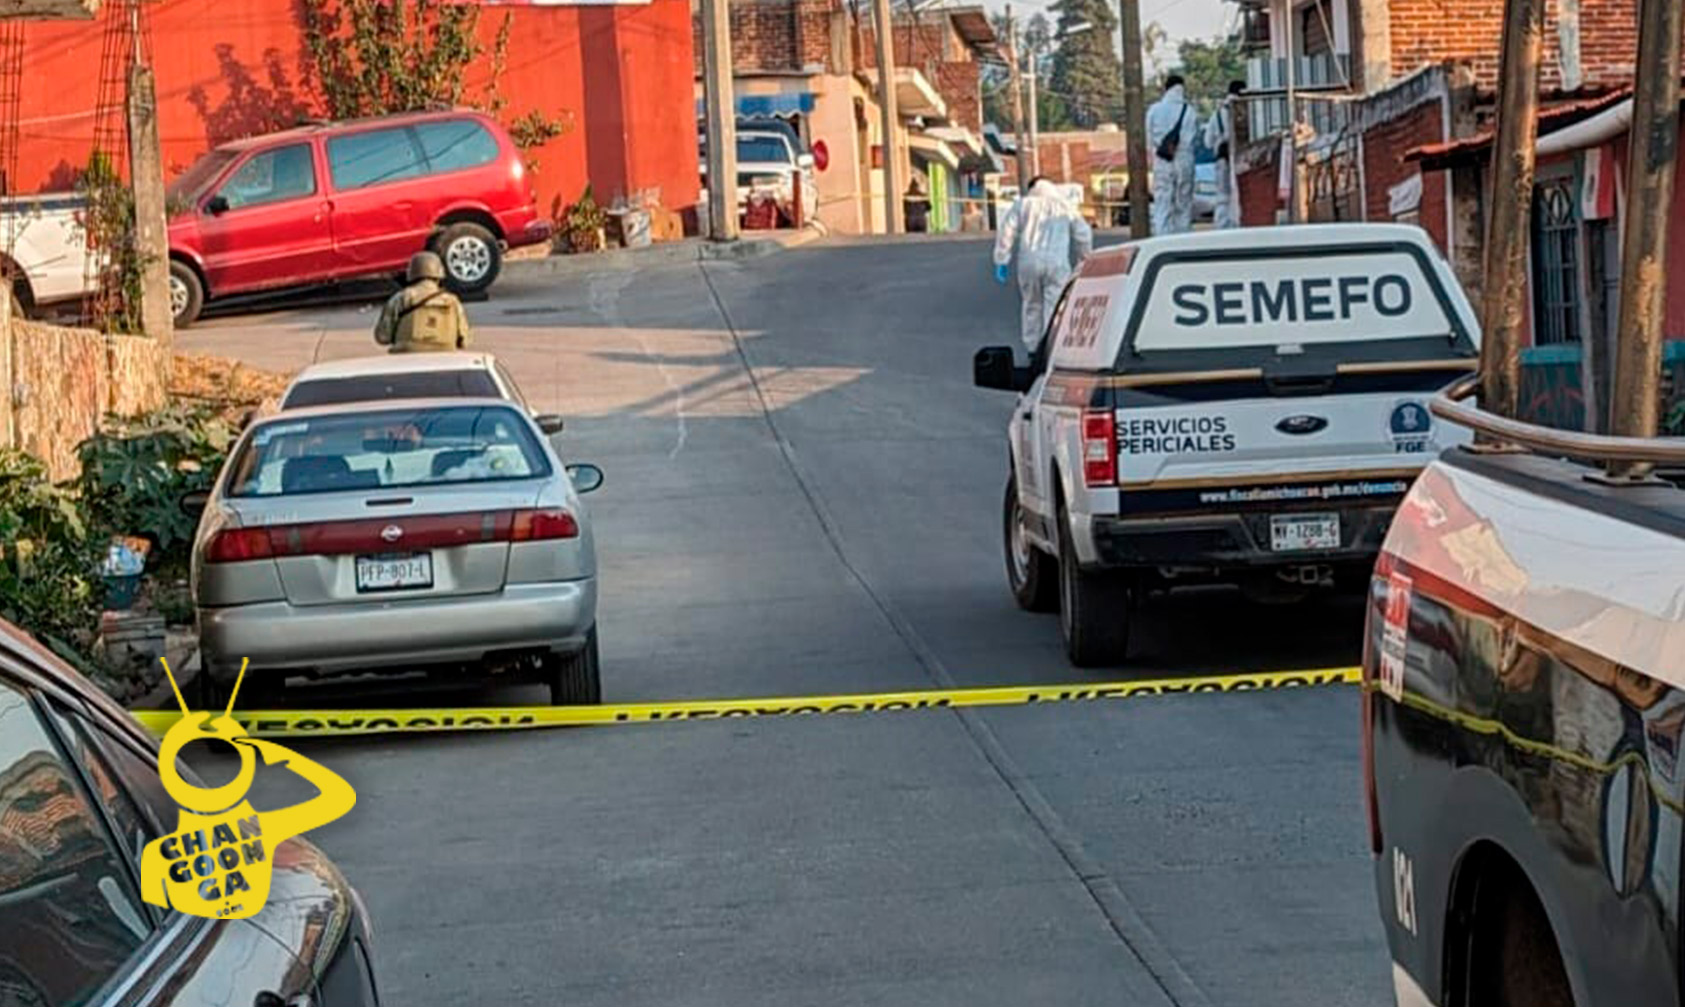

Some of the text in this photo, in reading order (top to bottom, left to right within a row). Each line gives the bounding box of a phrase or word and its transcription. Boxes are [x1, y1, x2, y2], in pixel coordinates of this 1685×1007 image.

[1172, 274, 1412, 326] SEMEFO
[1116, 416, 1226, 436] SERVICIOS
[1116, 434, 1236, 455] PERICIALES
[1395, 442, 1427, 455] FGE
